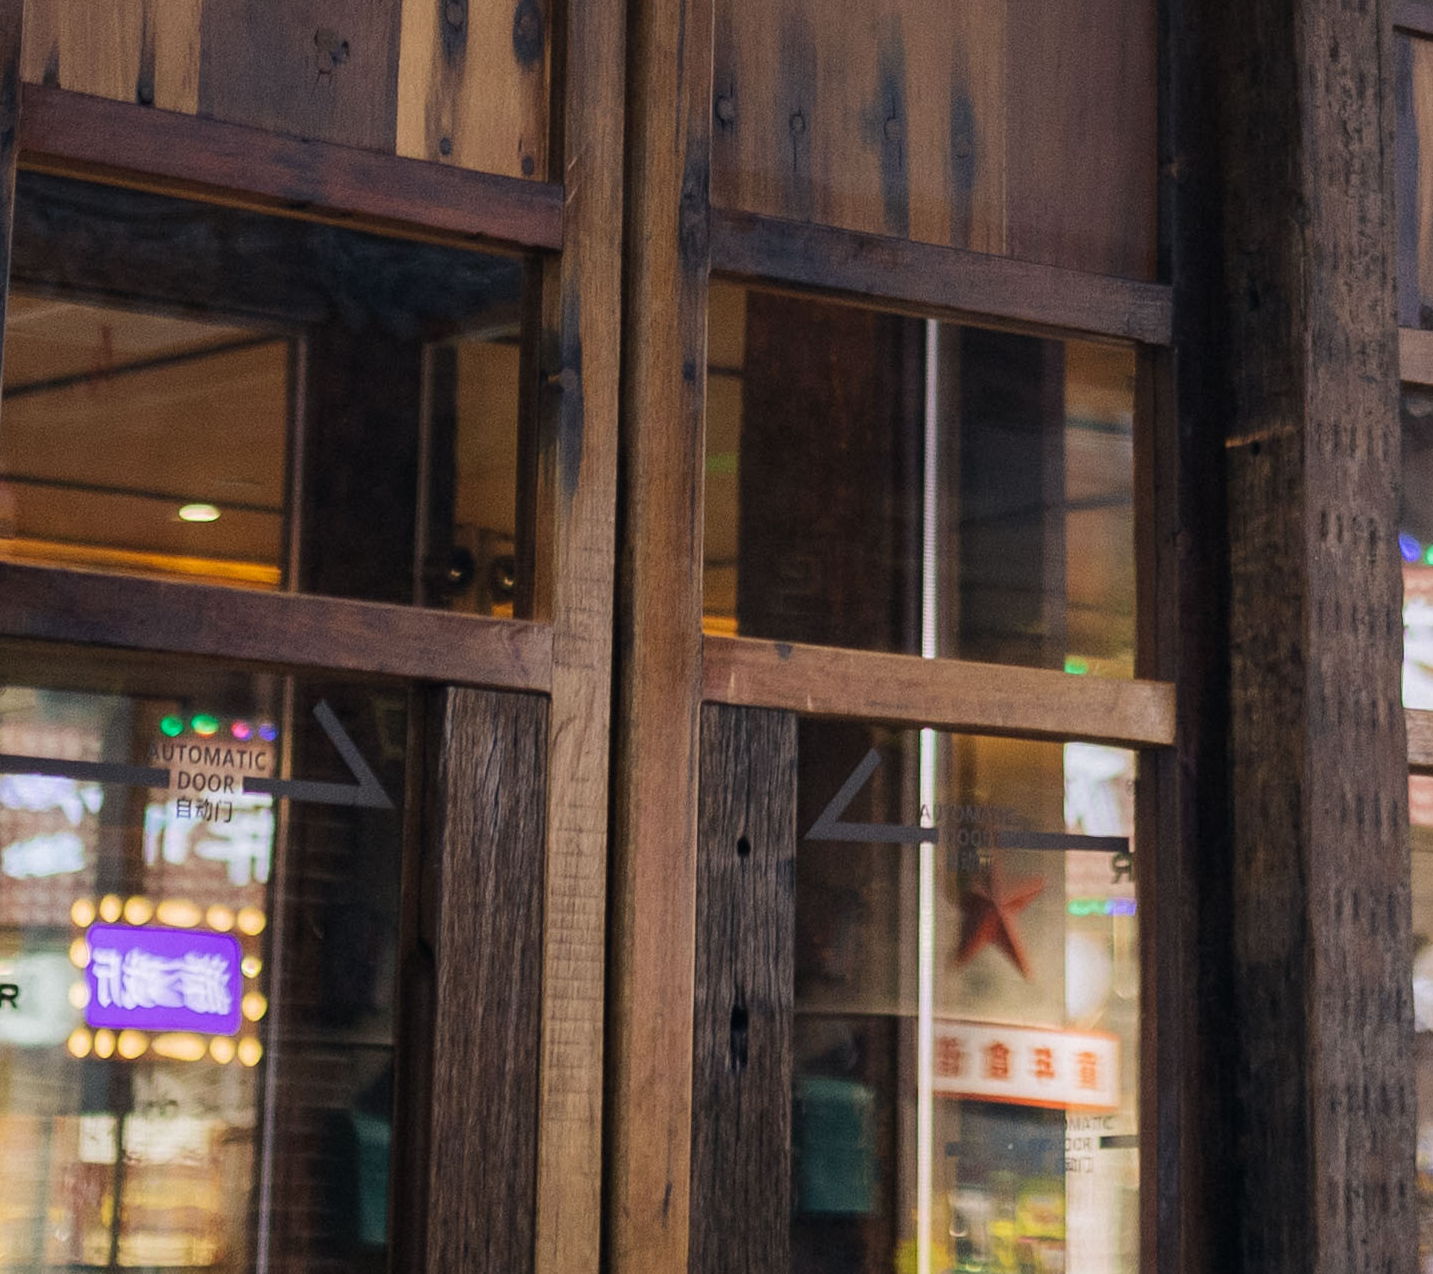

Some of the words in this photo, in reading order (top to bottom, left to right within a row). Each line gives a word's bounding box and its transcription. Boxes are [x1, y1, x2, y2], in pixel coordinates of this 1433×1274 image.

[150, 742, 266, 771] AUTOMATIC
[177, 771, 234, 794] DOOR
[176, 797, 233, 823] 自动门
